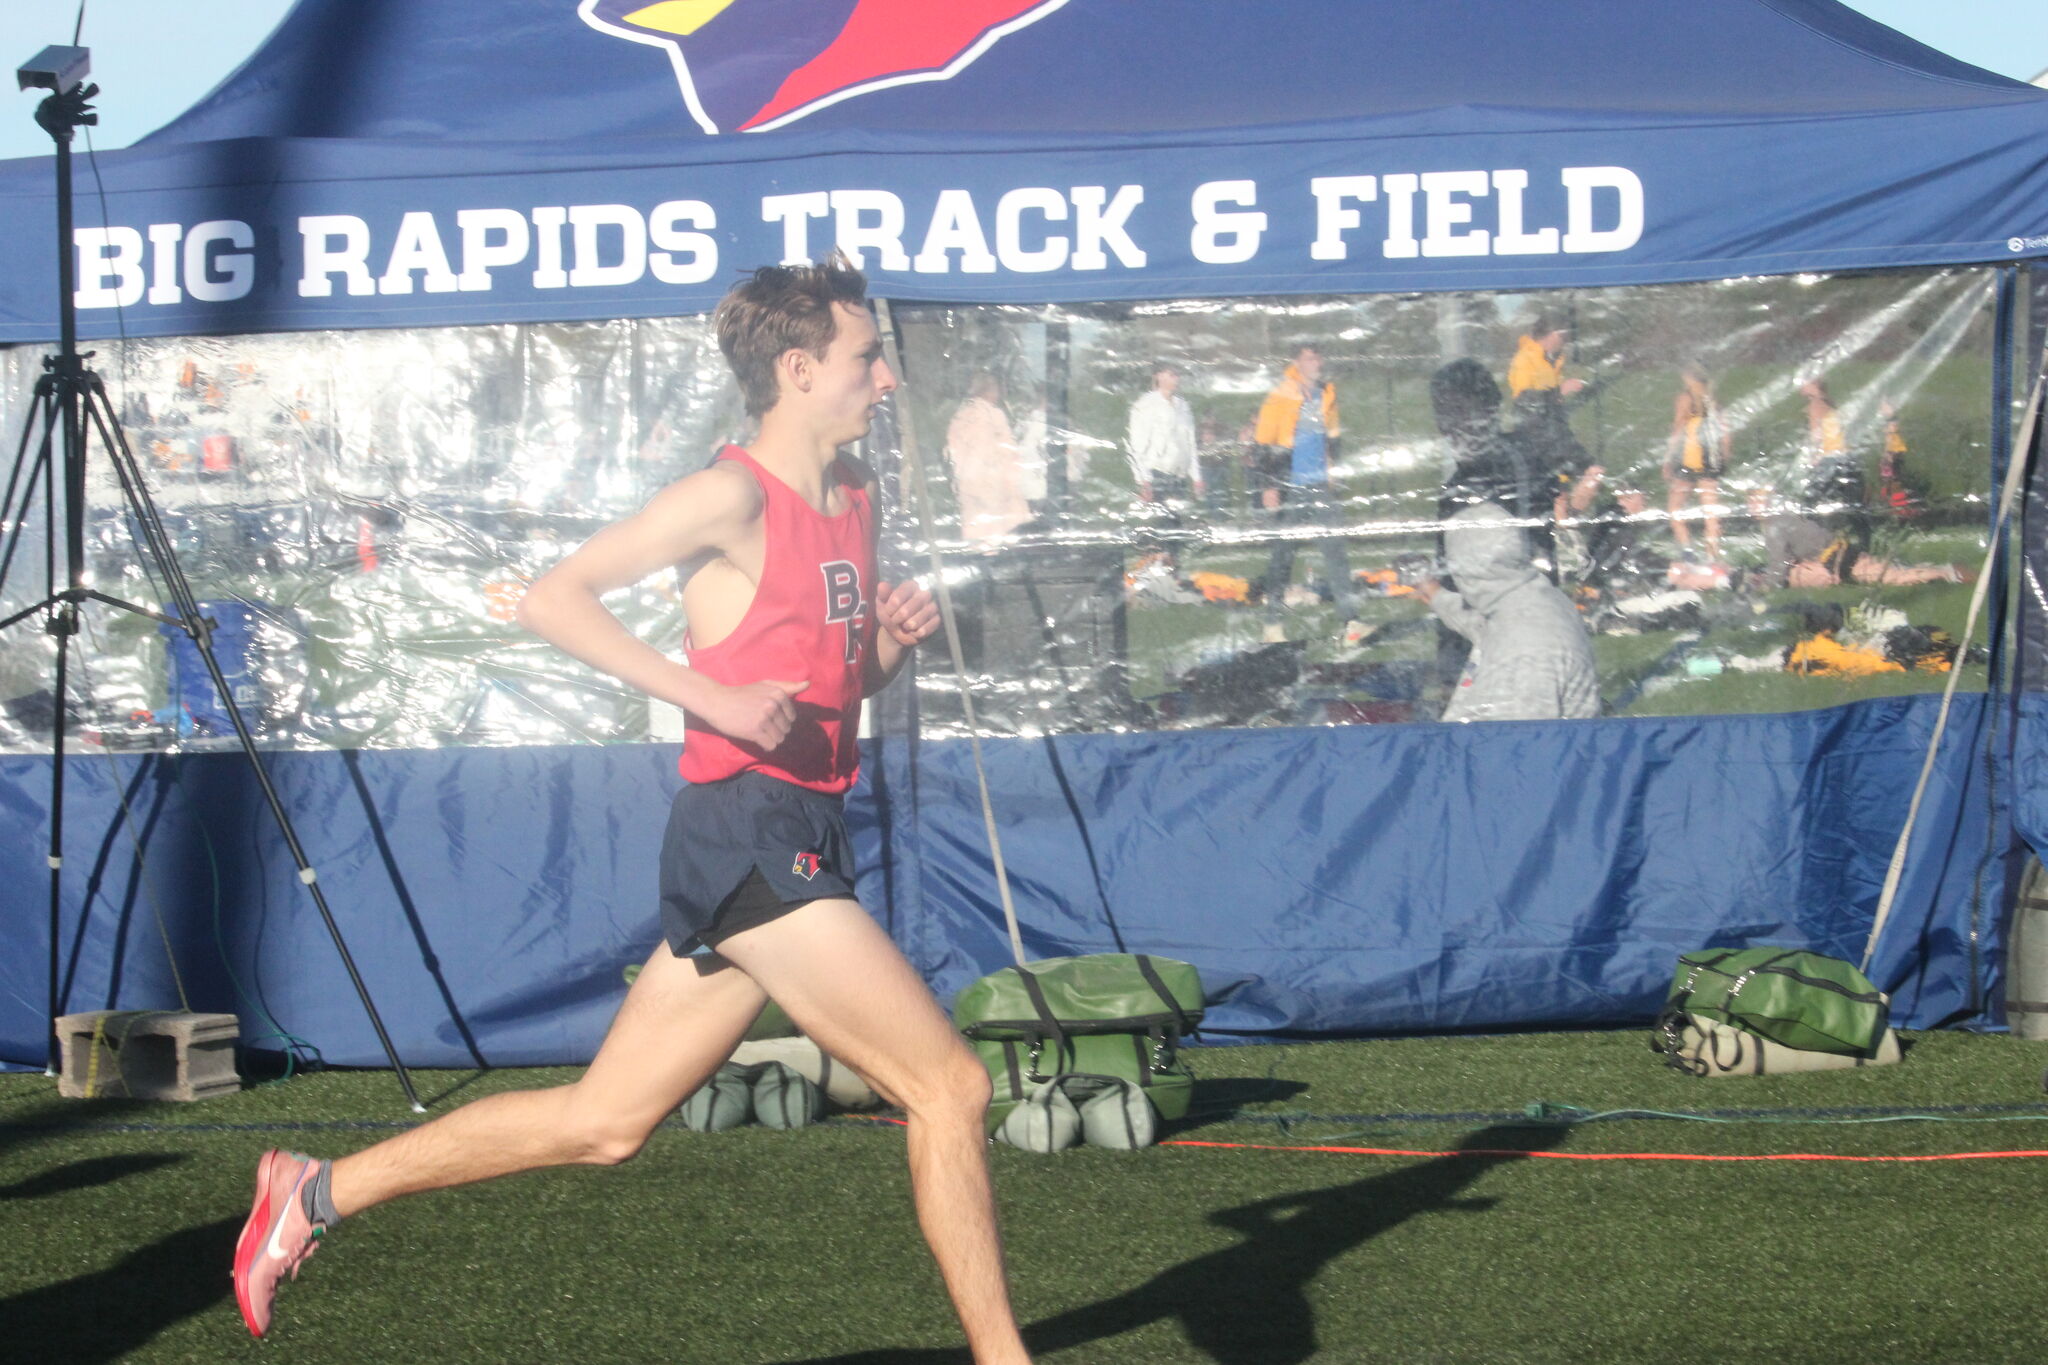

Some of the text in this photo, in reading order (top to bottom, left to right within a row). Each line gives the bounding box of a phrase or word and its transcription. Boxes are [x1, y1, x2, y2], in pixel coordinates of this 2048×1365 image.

[73, 165, 1646, 309] BIG RAPIDS TRACK & FIELD
